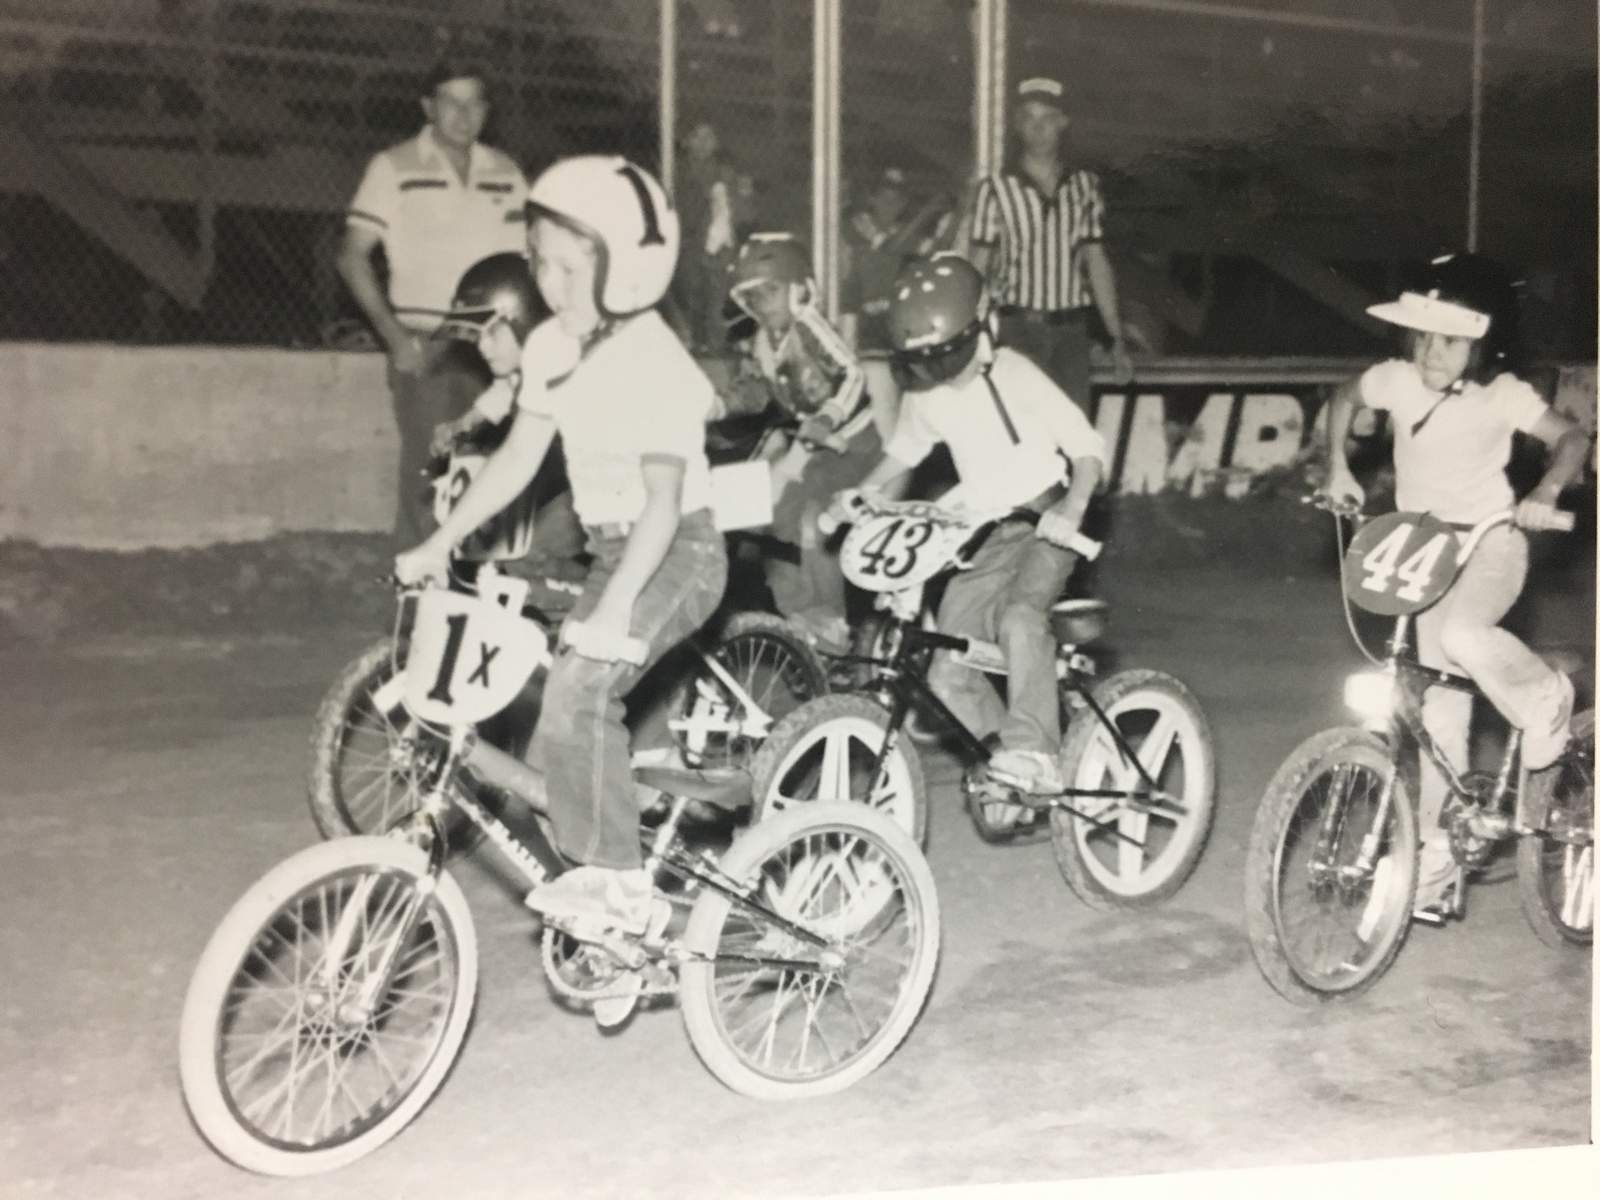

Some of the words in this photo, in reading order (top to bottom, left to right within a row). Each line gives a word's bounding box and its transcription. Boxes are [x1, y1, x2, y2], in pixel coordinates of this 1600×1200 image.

[615, 166, 666, 247] 1
[860, 519, 933, 579] 43
[1361, 522, 1449, 603] 44
